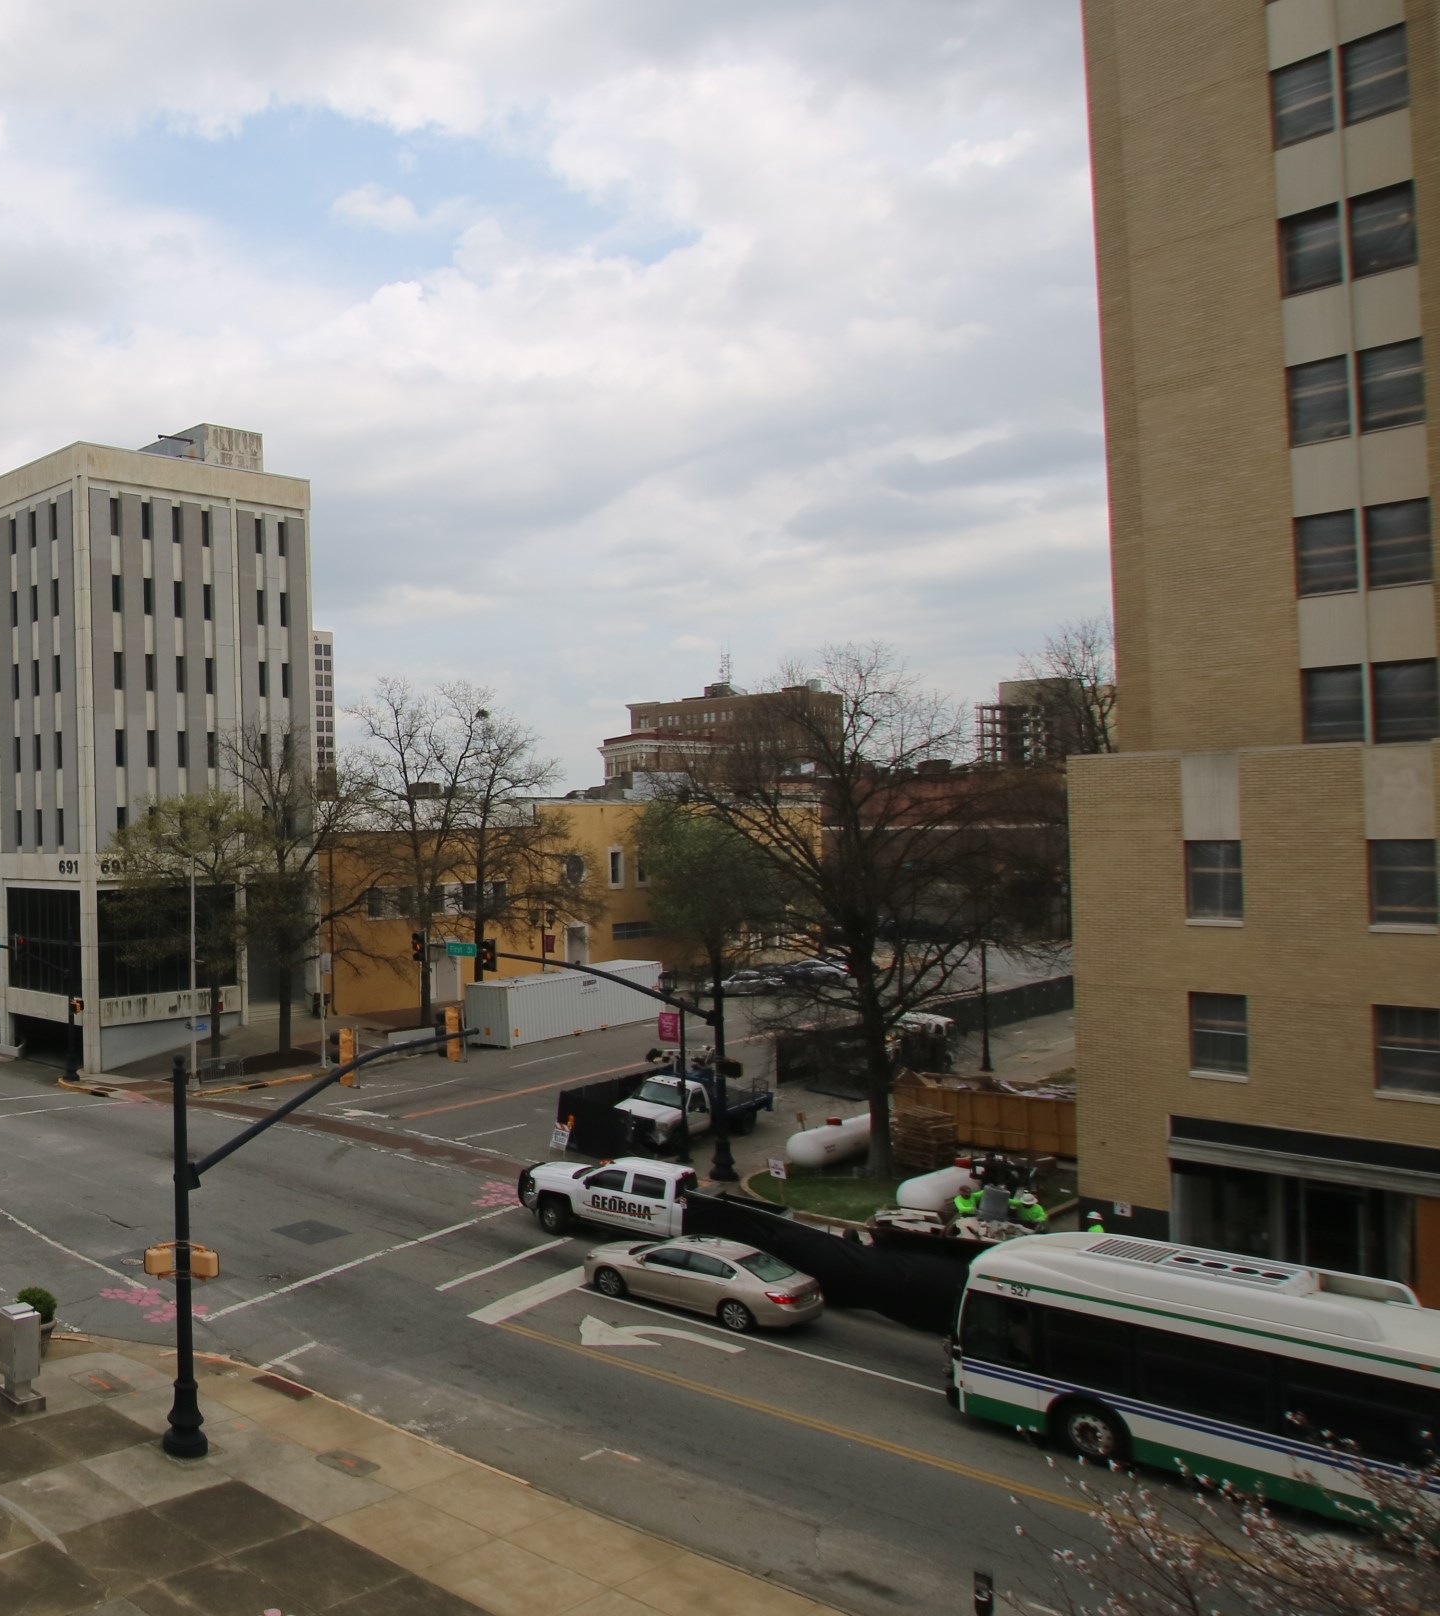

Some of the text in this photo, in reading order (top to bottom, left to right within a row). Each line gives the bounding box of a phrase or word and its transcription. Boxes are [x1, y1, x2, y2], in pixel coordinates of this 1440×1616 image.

[59, 860, 78, 874] 691
[592, 1194, 651, 1220] GEORGIA
[1011, 1283, 1030, 1297] 527
